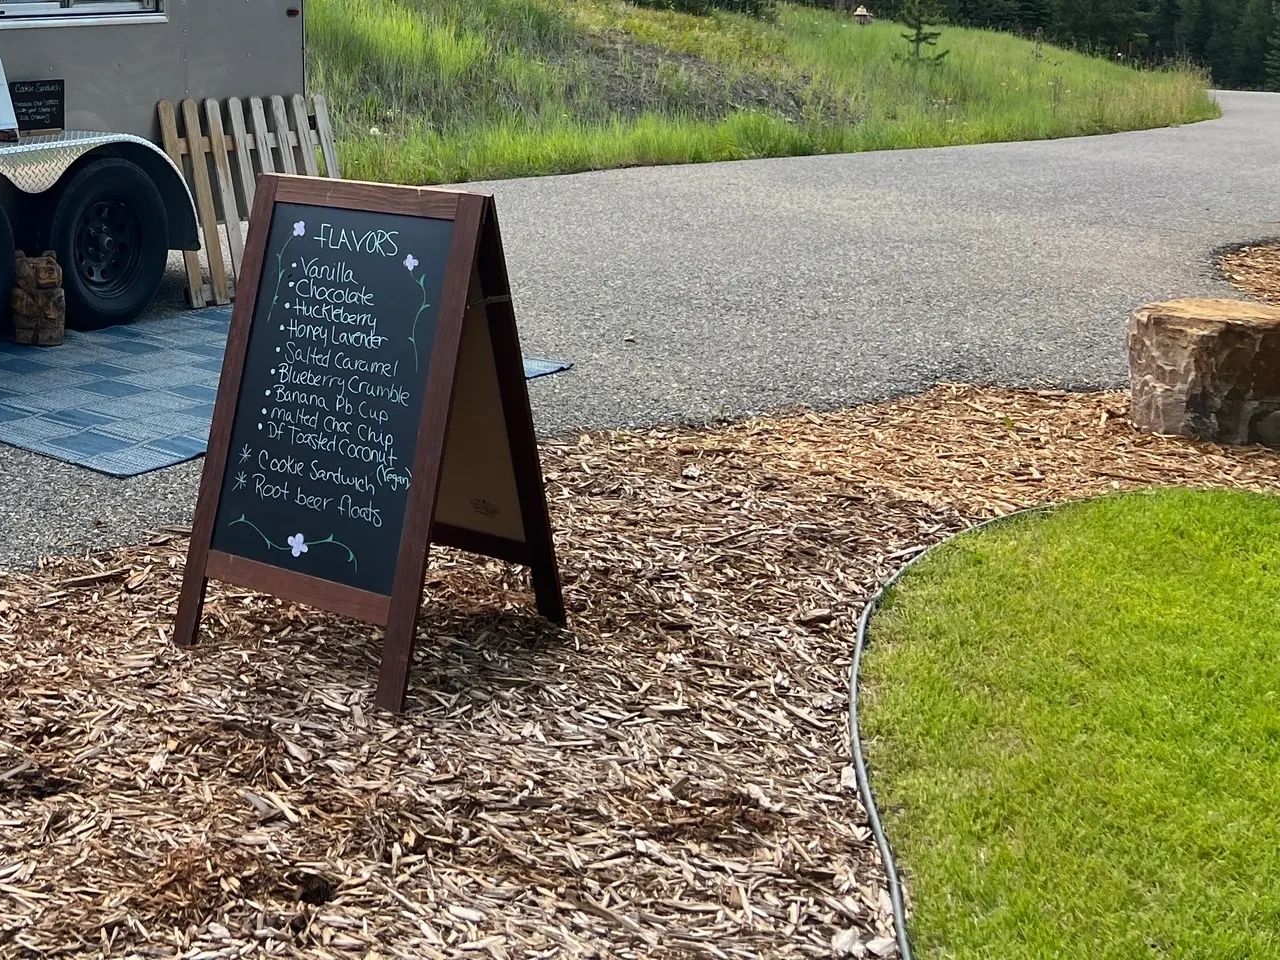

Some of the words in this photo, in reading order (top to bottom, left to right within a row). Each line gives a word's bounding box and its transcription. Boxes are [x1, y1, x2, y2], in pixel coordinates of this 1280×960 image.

[313, 223, 399, 257] FLAVORS
[300, 256, 358, 284] Vanilla
[295, 279, 375, 306] Chocolate
[286, 319, 329, 348] Honey
[331, 325, 388, 349] Lavender
[293, 298, 377, 334] Huckleberry
[284, 341, 330, 368] Salted
[334, 352, 398, 377] Caramel
[273, 384, 330, 411] Banana
[359, 401, 389, 422] Cup
[278, 363, 346, 393] Blueberry
[348, 375, 410, 407] Crumble
[288, 426, 336, 452] Toasted
[338, 438, 398, 467] Coconut
[357, 424, 394, 448] Chip
[258, 449, 305, 478] Cookie
[309, 460, 376, 495] Sandwich
[252, 473, 290, 500] Root
[294, 488, 334, 512] beer
[337, 494, 383, 528] floats
